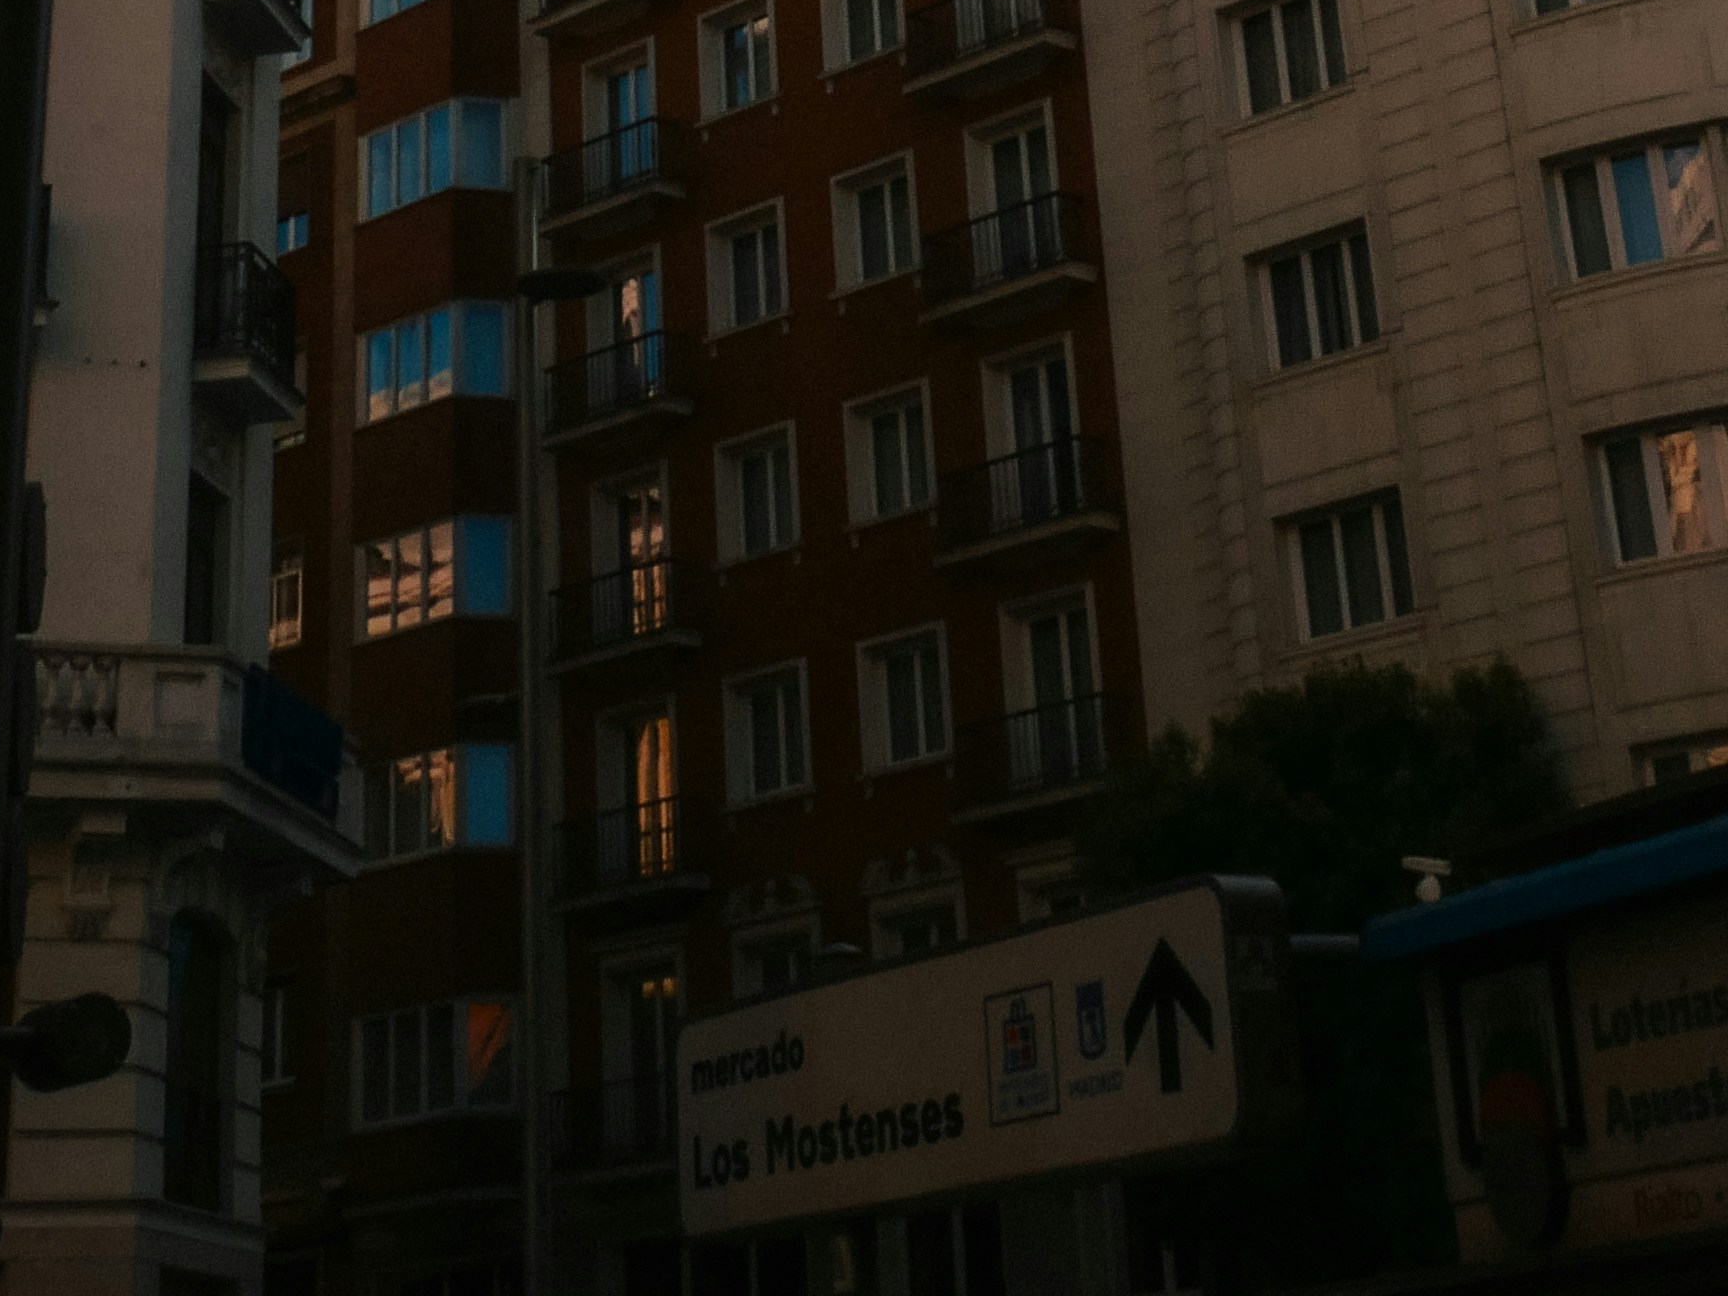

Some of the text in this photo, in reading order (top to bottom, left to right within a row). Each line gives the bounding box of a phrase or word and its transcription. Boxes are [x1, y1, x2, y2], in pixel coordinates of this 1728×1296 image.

[691, 1030, 805, 1095] mercado
[693, 1135, 749, 1189] Los
[765, 1092, 964, 1176] Mostenses
